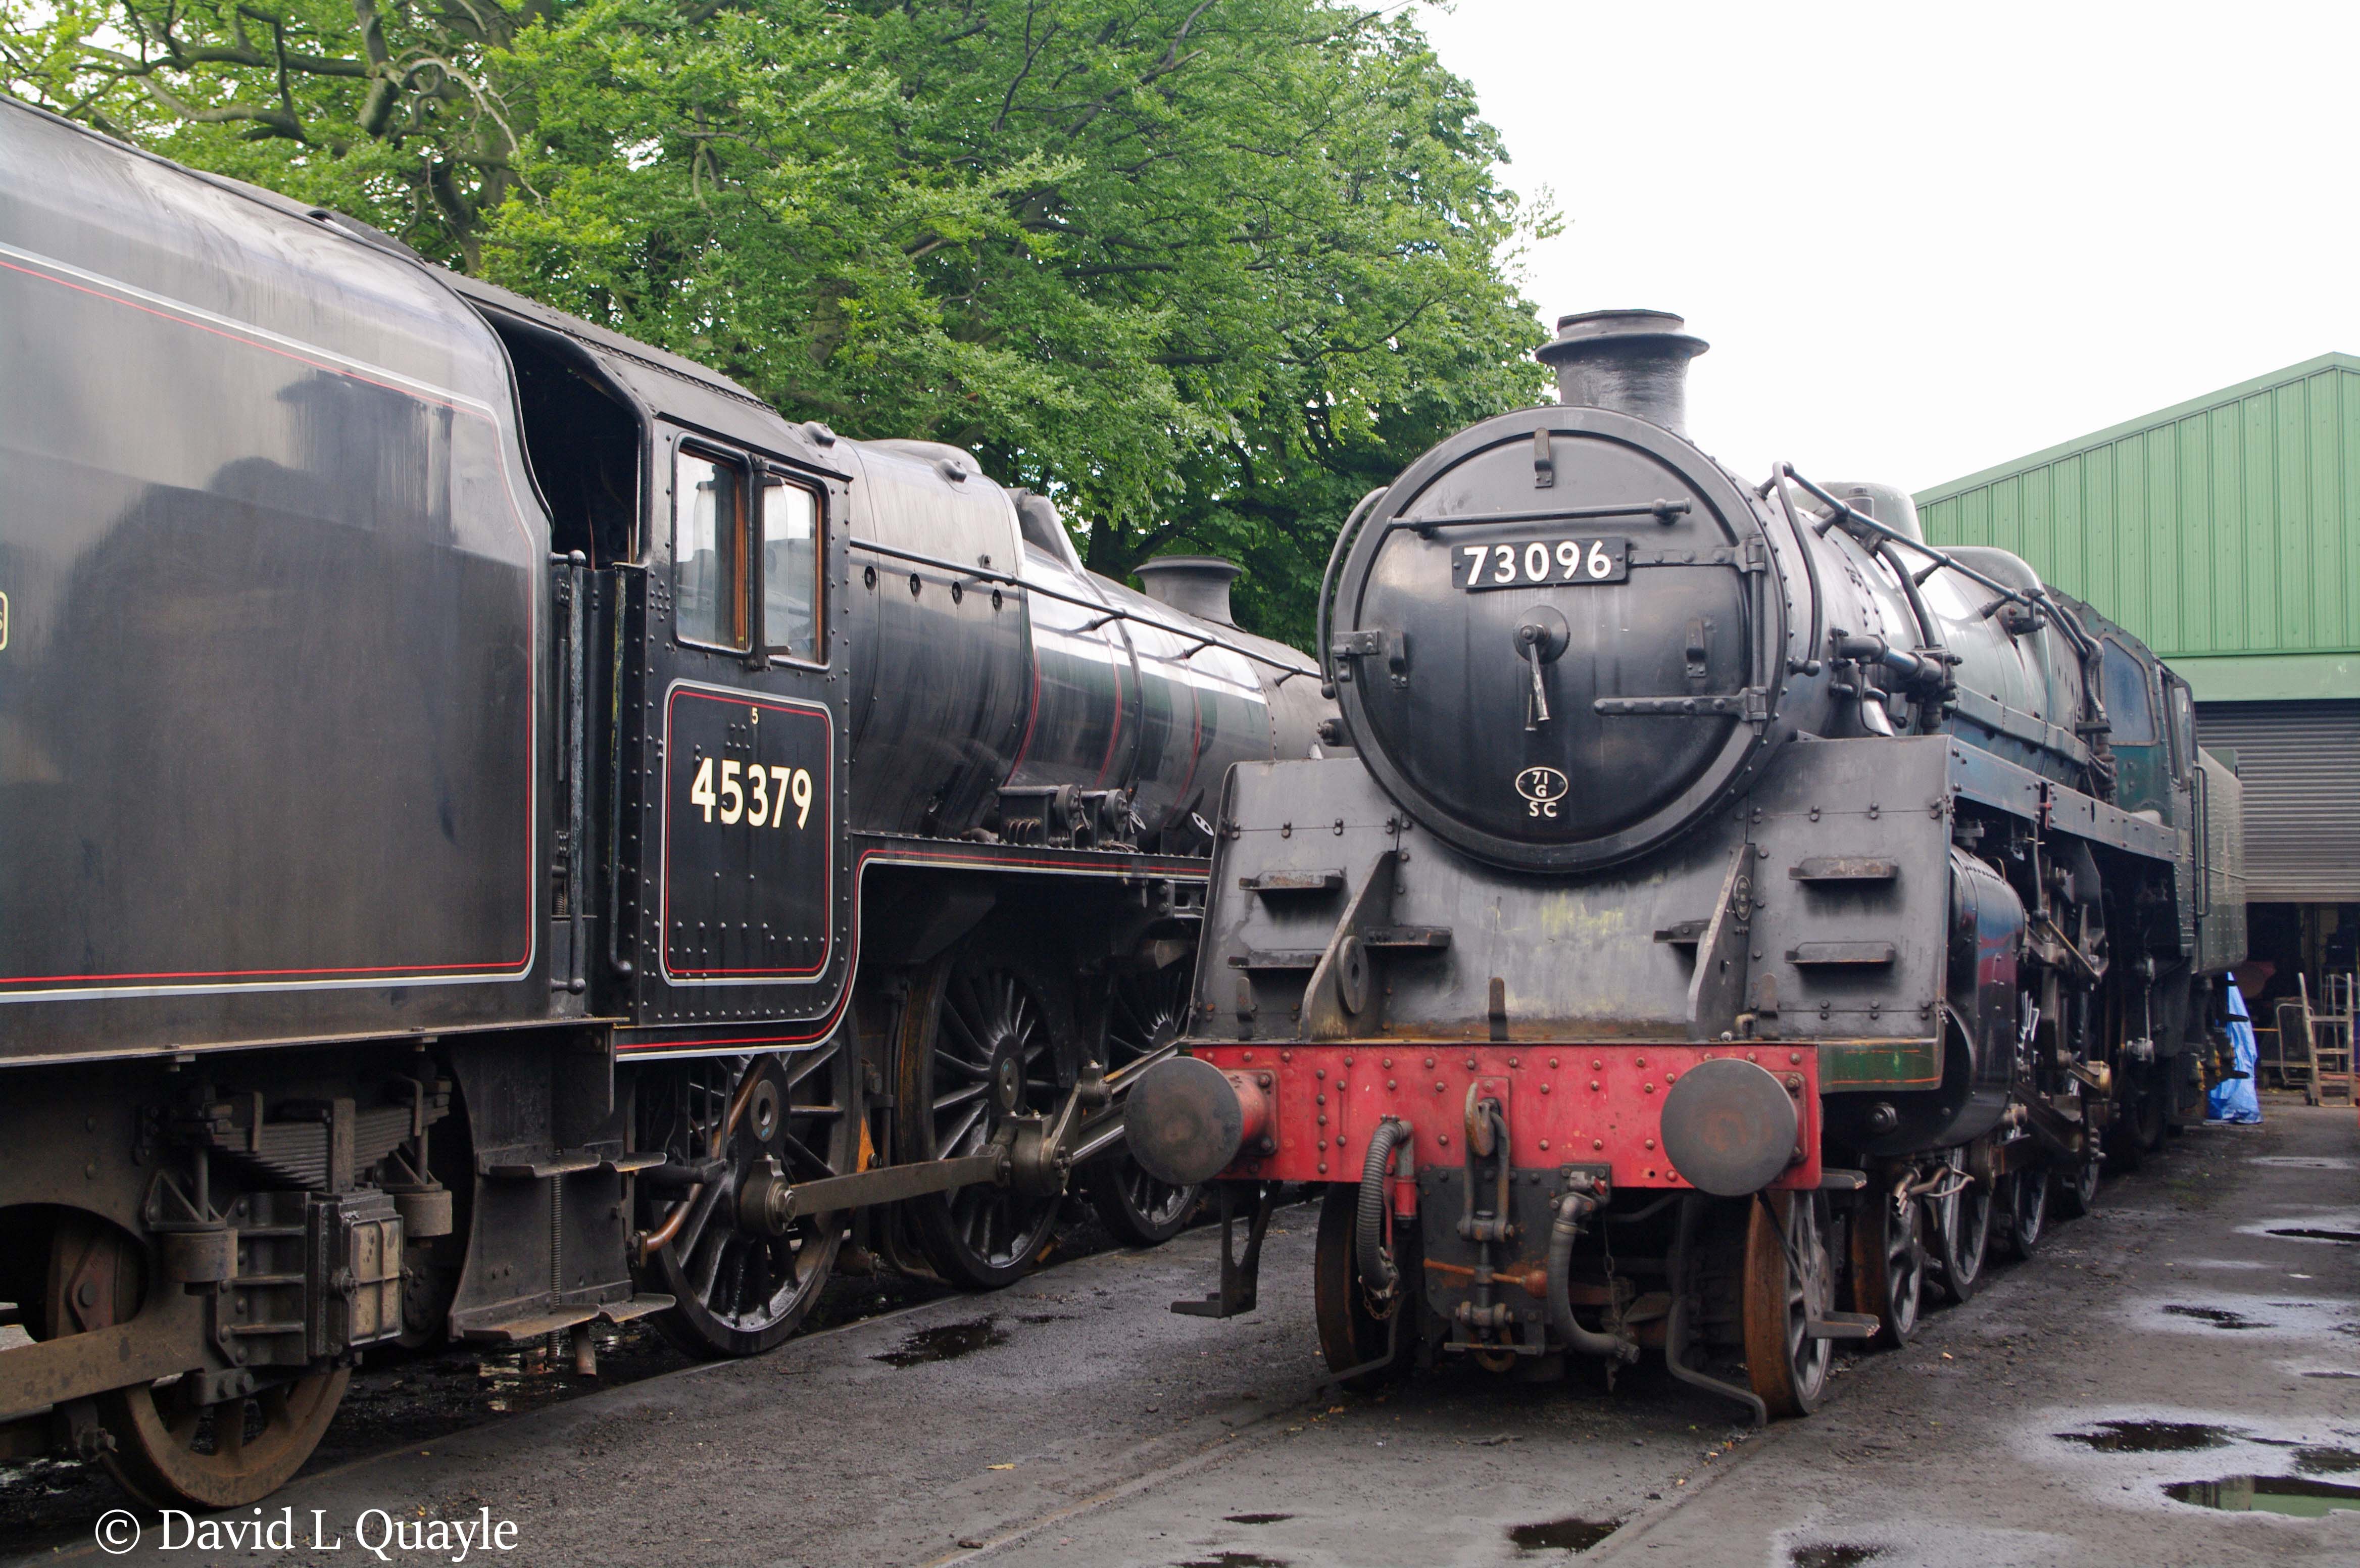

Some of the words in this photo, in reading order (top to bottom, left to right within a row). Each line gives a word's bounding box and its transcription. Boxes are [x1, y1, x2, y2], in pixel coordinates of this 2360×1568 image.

[1464, 540, 1611, 585] 73096
[752, 707, 759, 725] 5
[1532, 771, 1548, 785] 71
[692, 757, 812, 830] 45379
[1535, 785, 1547, 797] G
[1529, 801, 1557, 817] SC
